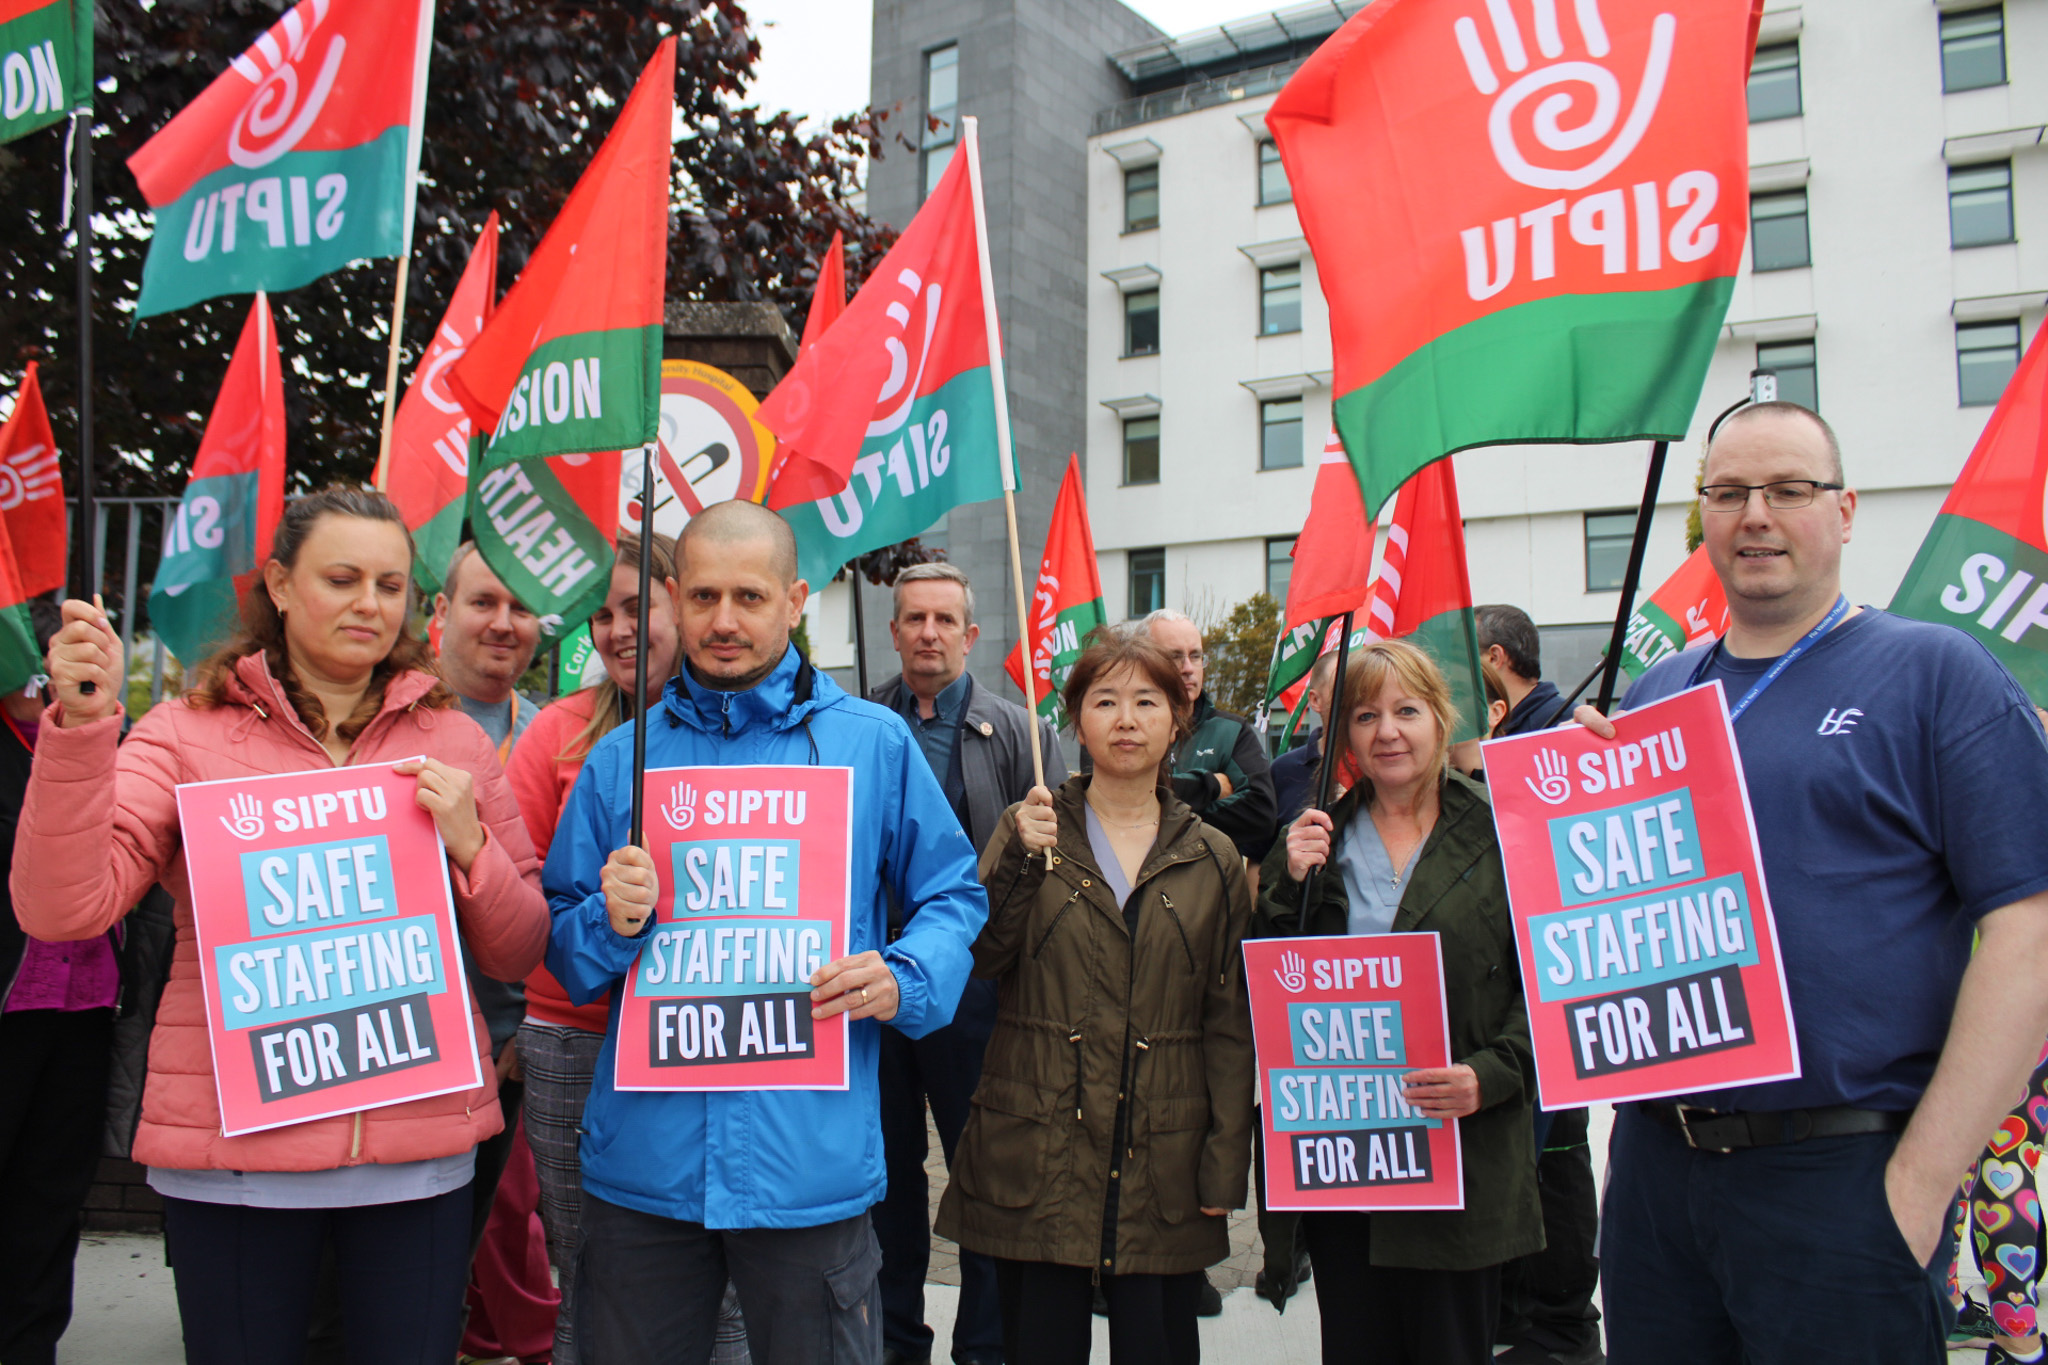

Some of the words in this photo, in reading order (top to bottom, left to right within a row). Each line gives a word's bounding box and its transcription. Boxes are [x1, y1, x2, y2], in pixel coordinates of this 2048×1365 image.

[0, 40, 64, 120] ON
[487, 357, 602, 449] ISION
[1940, 552, 2048, 643] SIP
[565, 634, 593, 675] Cork
[1577, 726, 1688, 794] SIPTU
[272, 786, 387, 832] SIPTU
[703, 789, 807, 825] SIPTU
[685, 846, 788, 911] SAFE
[1569, 798, 1693, 894] SAFE
[259, 843, 385, 926] SAFE
[229, 925, 435, 1013] STAFFING
[646, 927, 821, 984] STAFFING
[1543, 886, 1746, 986] STAFFING
[1312, 956, 1402, 990] SIPTU
[260, 1021, 347, 1094] FOR
[356, 1003, 432, 1073] ALL
[658, 1003, 728, 1061] FOR
[738, 999, 807, 1057] ALL
[1301, 1007, 1397, 1061] SAFE
[1573, 996, 1659, 1071] FOR
[1665, 976, 1745, 1053] ALL
[1298, 1136, 1360, 1185] FOR
[1368, 1131, 1426, 1181] ALL
